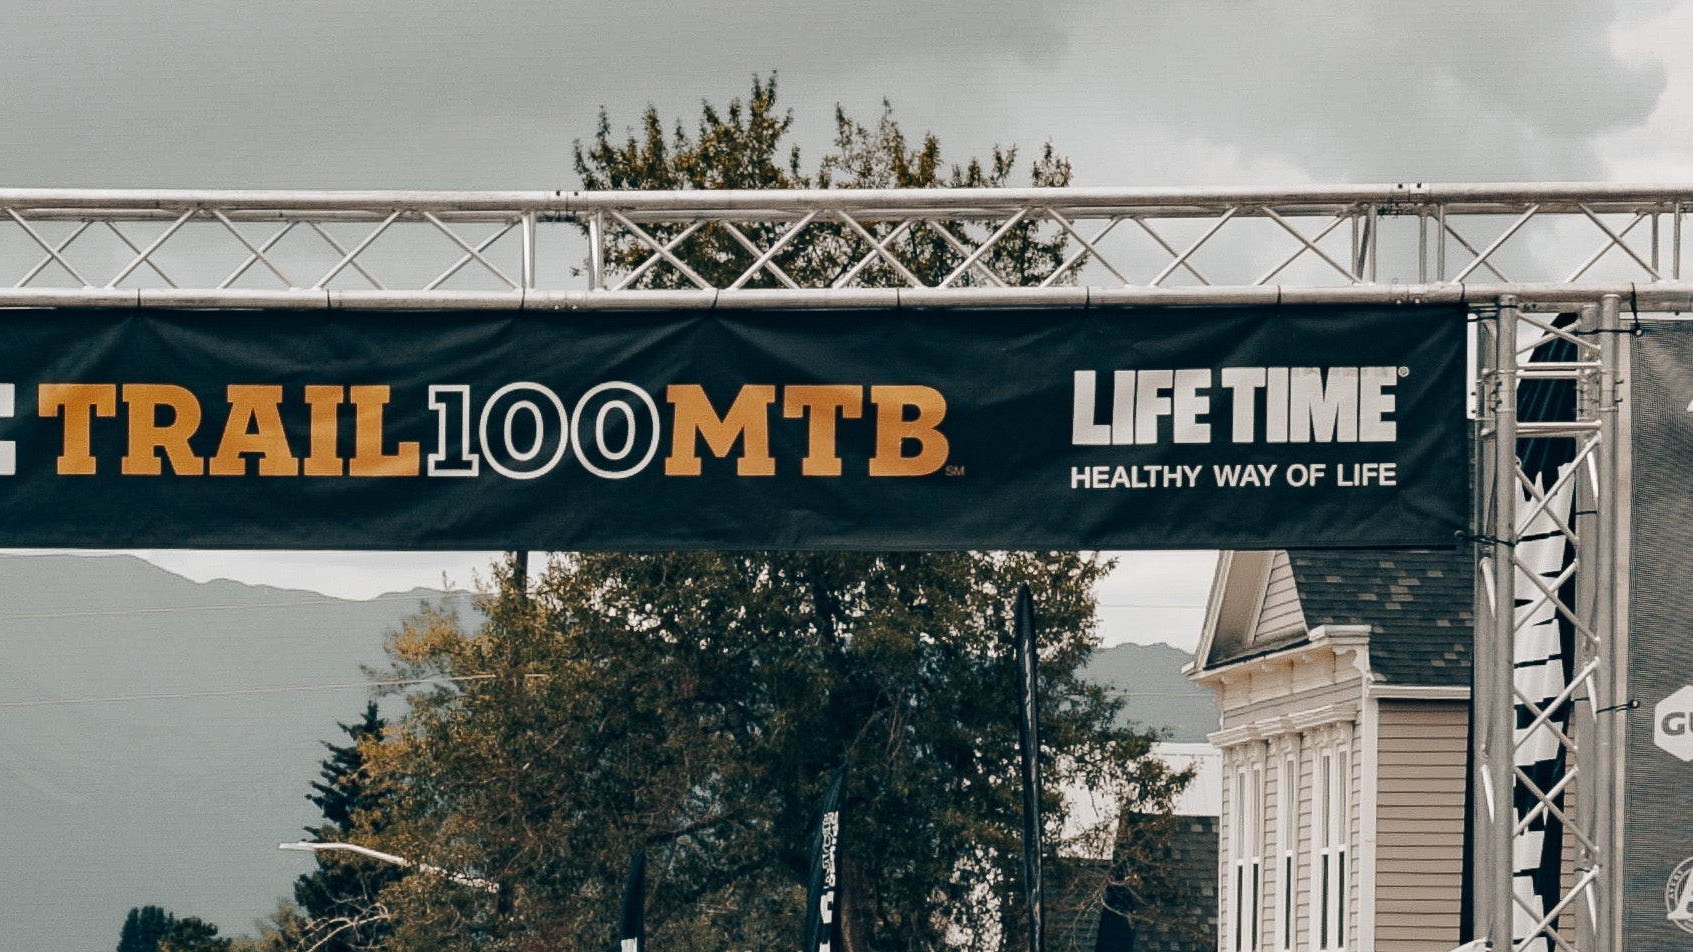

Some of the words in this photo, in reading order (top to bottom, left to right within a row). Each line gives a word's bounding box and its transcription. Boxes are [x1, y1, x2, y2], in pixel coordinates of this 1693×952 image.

[1071, 465, 1203, 488] HEALTHY
[1213, 465, 1277, 487] WAY
[1287, 464, 1326, 487] OF
[1337, 463, 1397, 486] LIFE
